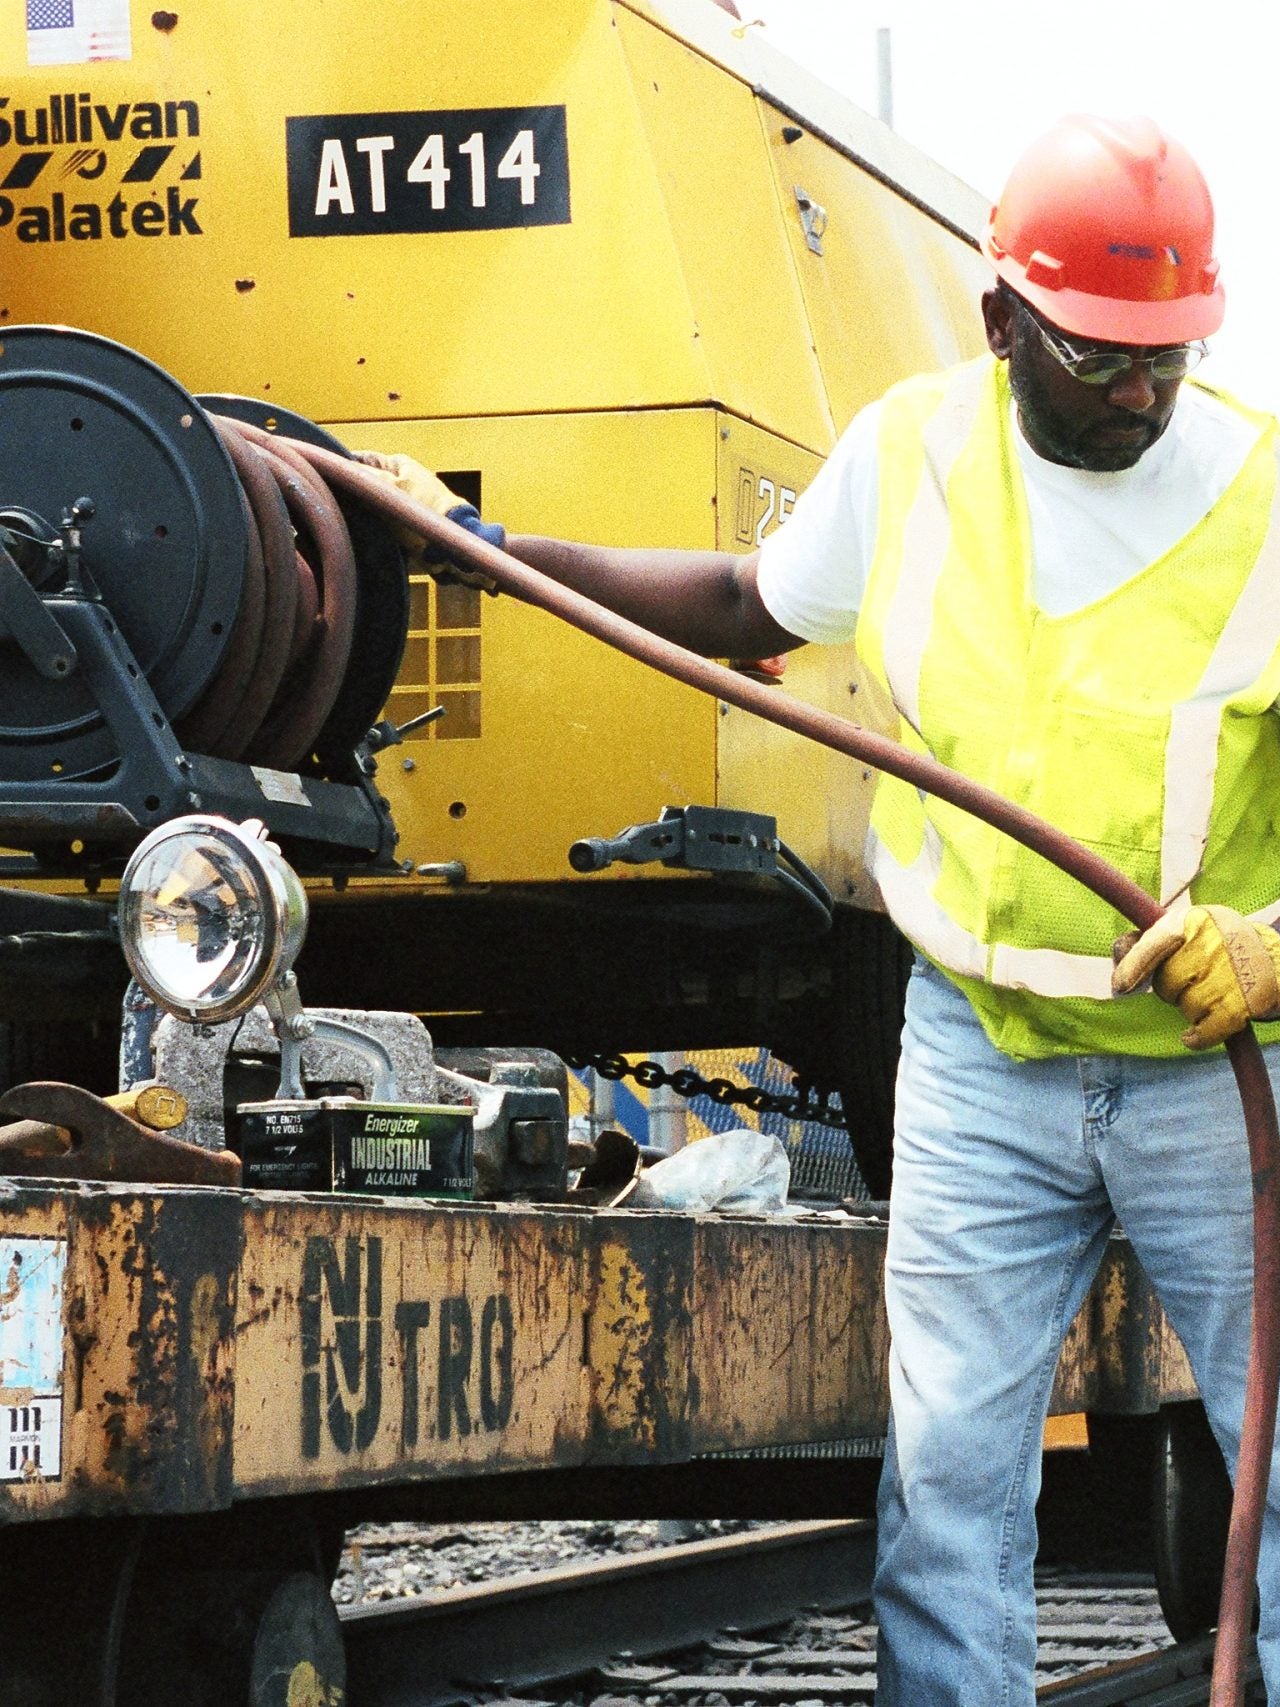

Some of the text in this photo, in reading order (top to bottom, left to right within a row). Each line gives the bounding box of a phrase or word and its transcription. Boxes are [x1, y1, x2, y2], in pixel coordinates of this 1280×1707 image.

[283, 1125, 304, 1134] VOLTS
[365, 1114, 419, 1137] Energizer
[351, 1137, 432, 1171] INDUSTRIAL
[365, 1172, 418, 1186] ALKALINE
